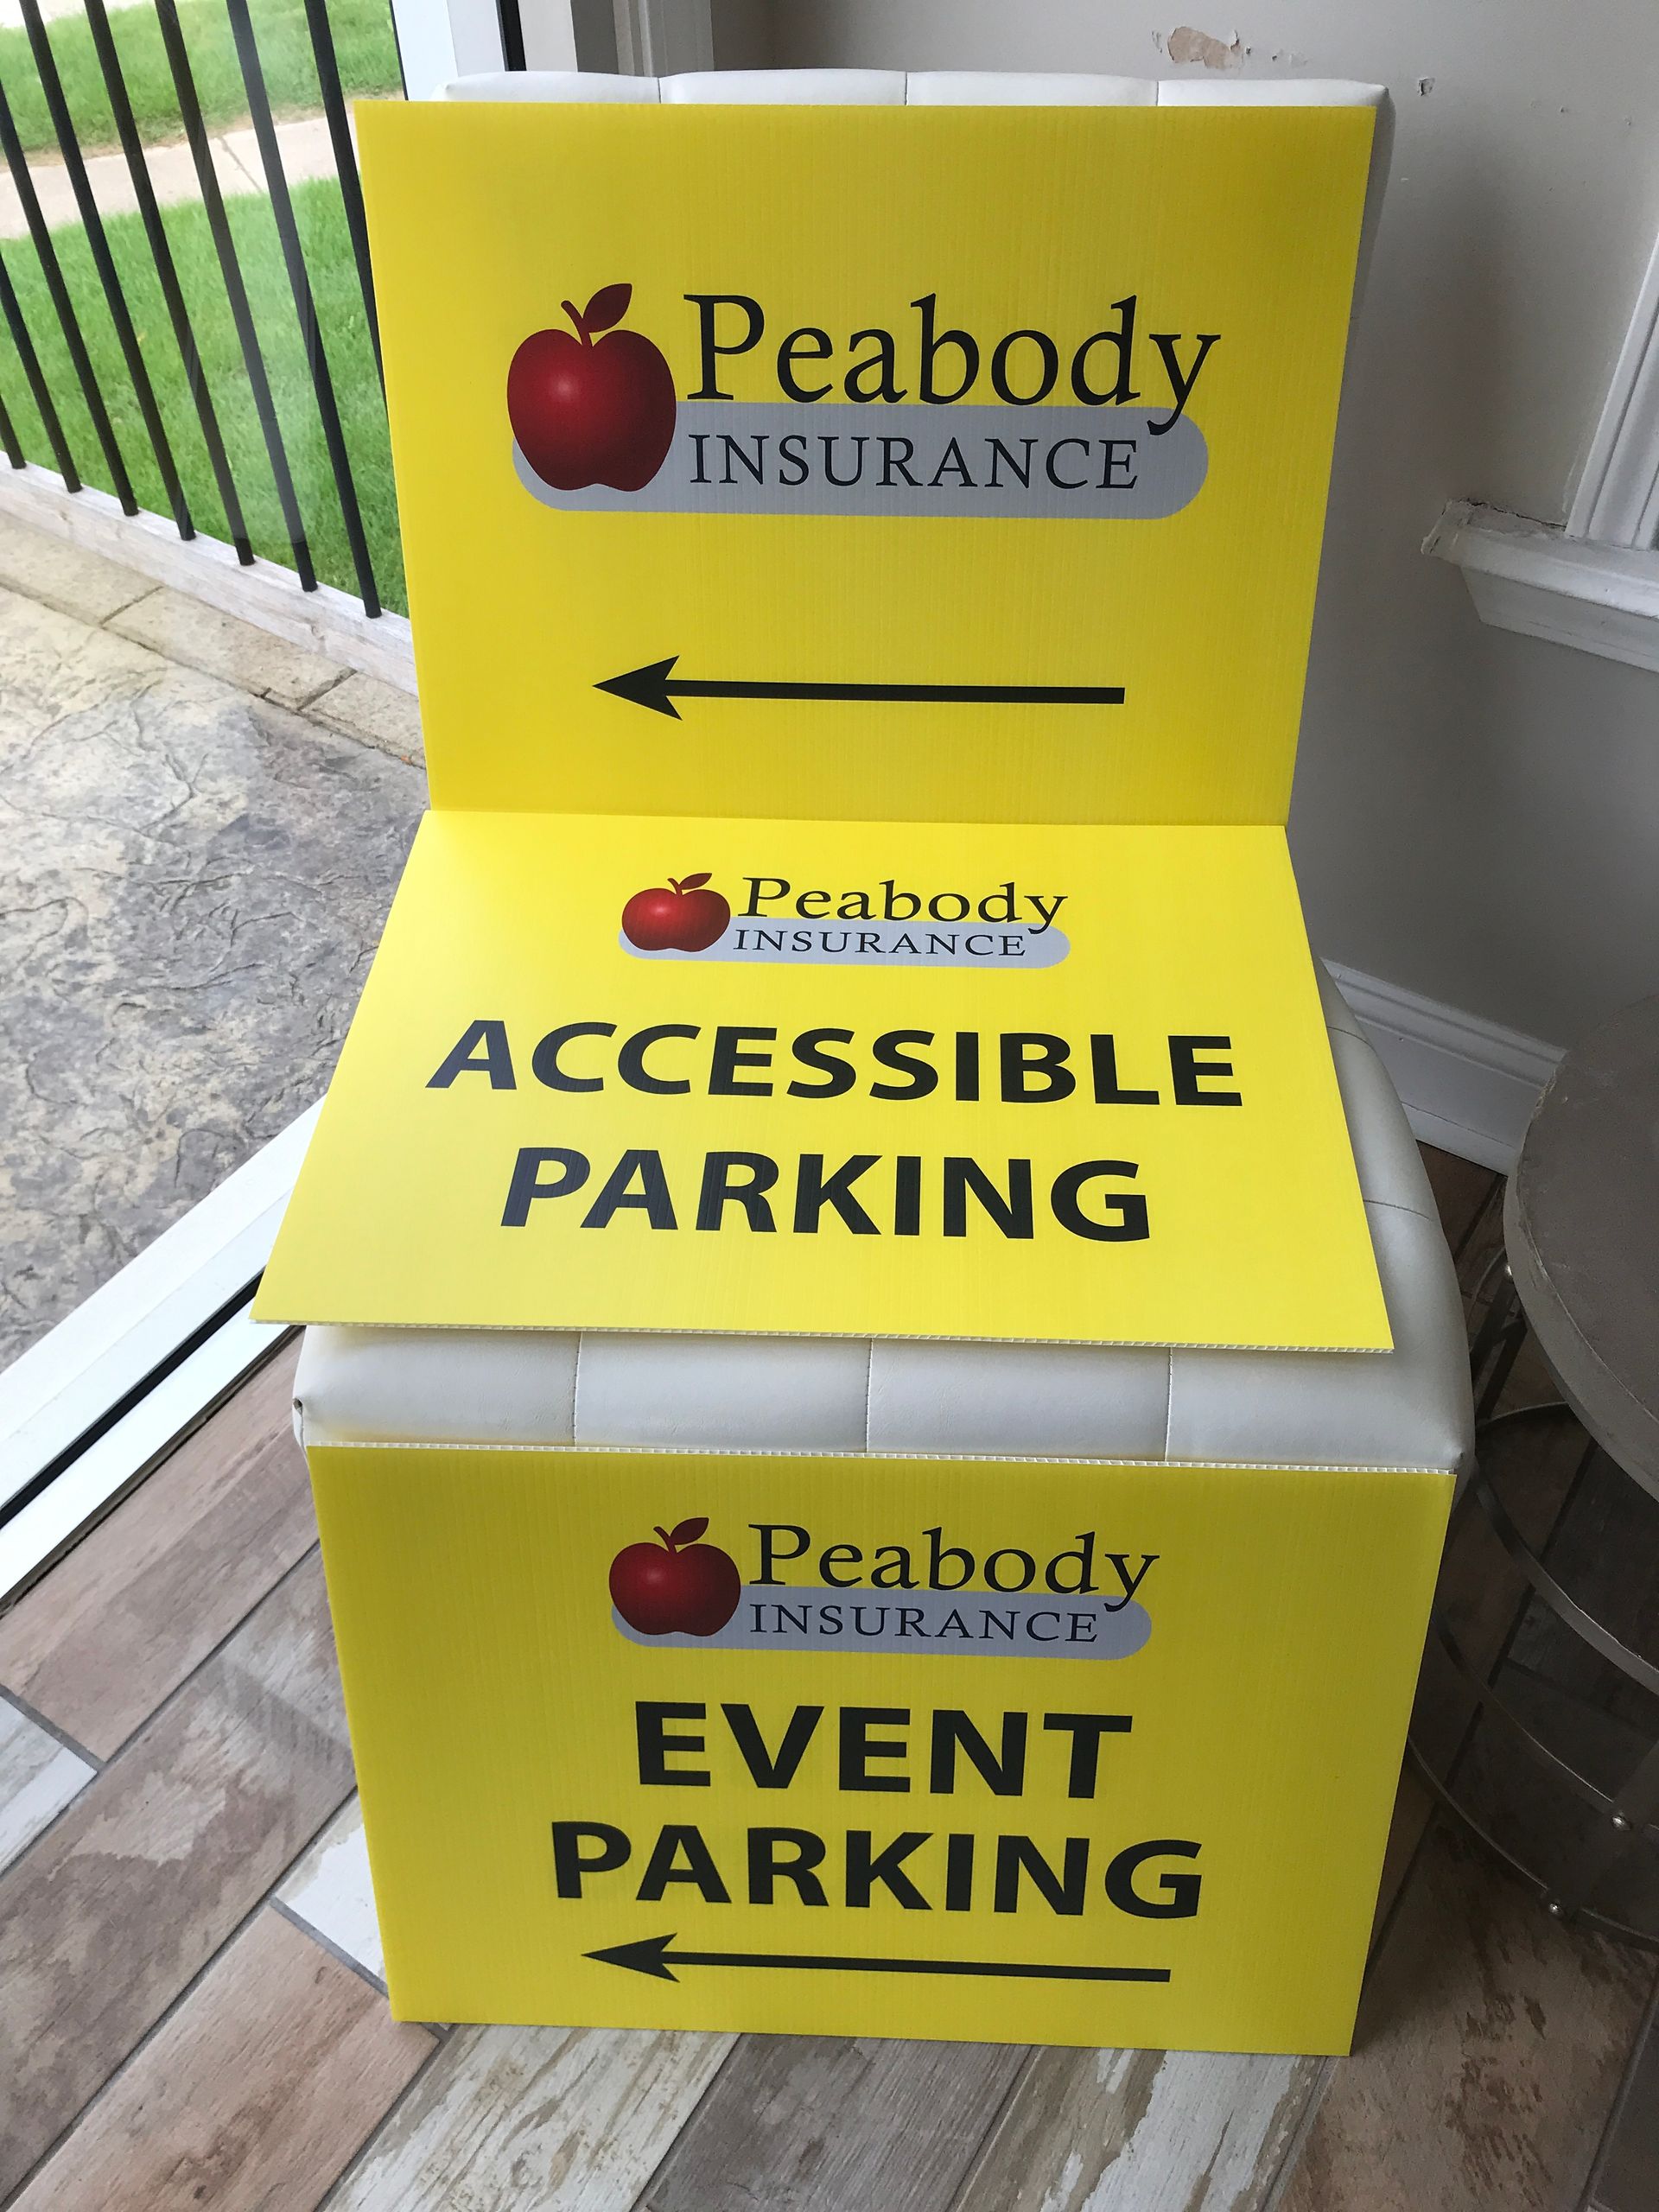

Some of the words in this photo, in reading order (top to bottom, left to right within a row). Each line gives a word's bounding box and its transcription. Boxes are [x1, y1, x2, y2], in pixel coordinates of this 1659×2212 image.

[683, 293, 1222, 436] Peabody
[688, 434, 1139, 490] INSURANCE
[733, 929, 1026, 957] INSURANCE
[737, 877, 1069, 935] Peabody
[425, 1020, 1243, 1107] ACCESSIBLE
[500, 1147, 1152, 1243] PARKING
[747, 1523, 1160, 1611] Peabody
[748, 1603, 1099, 1643] INSURANCE
[634, 1700, 1135, 1800] EVENT
[550, 1821, 1205, 1921] PARKING
